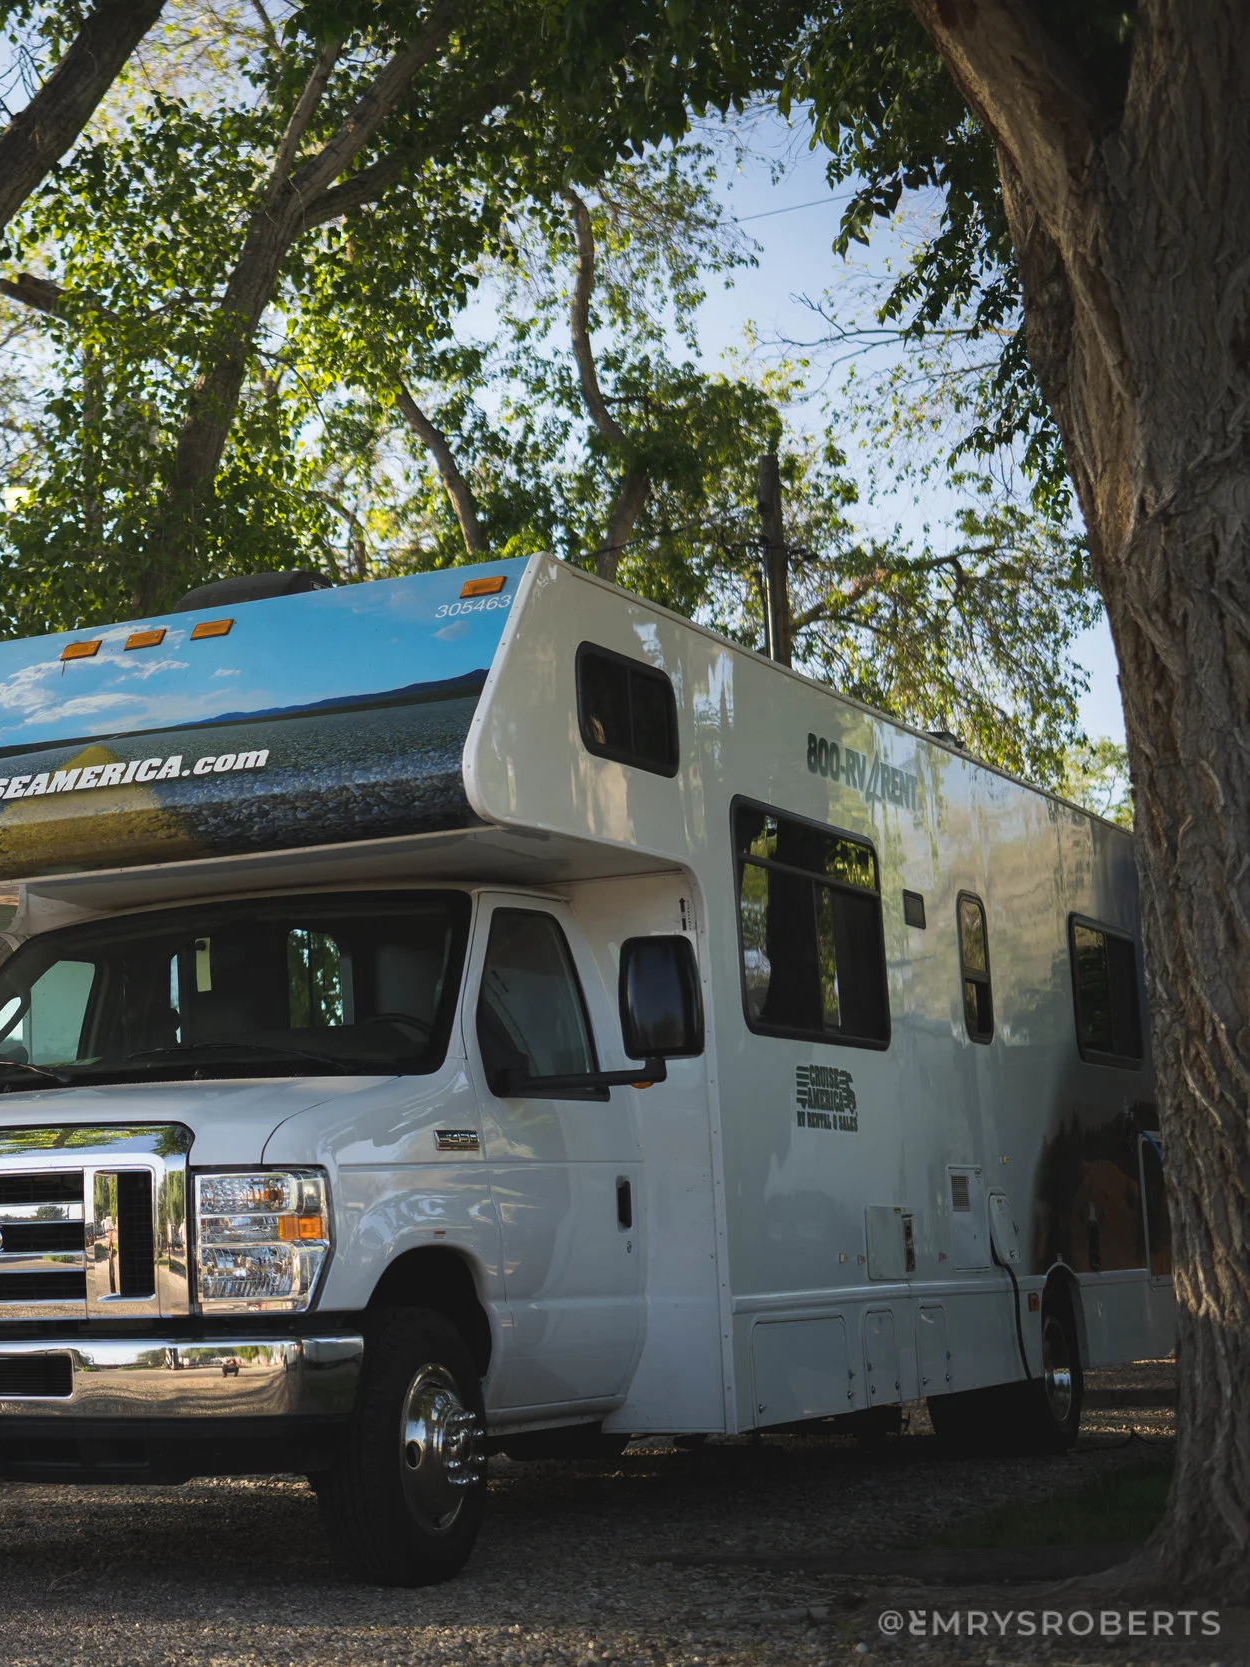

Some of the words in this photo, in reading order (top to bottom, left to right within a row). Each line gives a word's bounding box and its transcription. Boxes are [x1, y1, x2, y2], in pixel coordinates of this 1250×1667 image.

[434, 594, 512, 619] 305463
[809, 1064, 840, 1090] CRUISE
[807, 1087, 845, 1113] AMERICA
